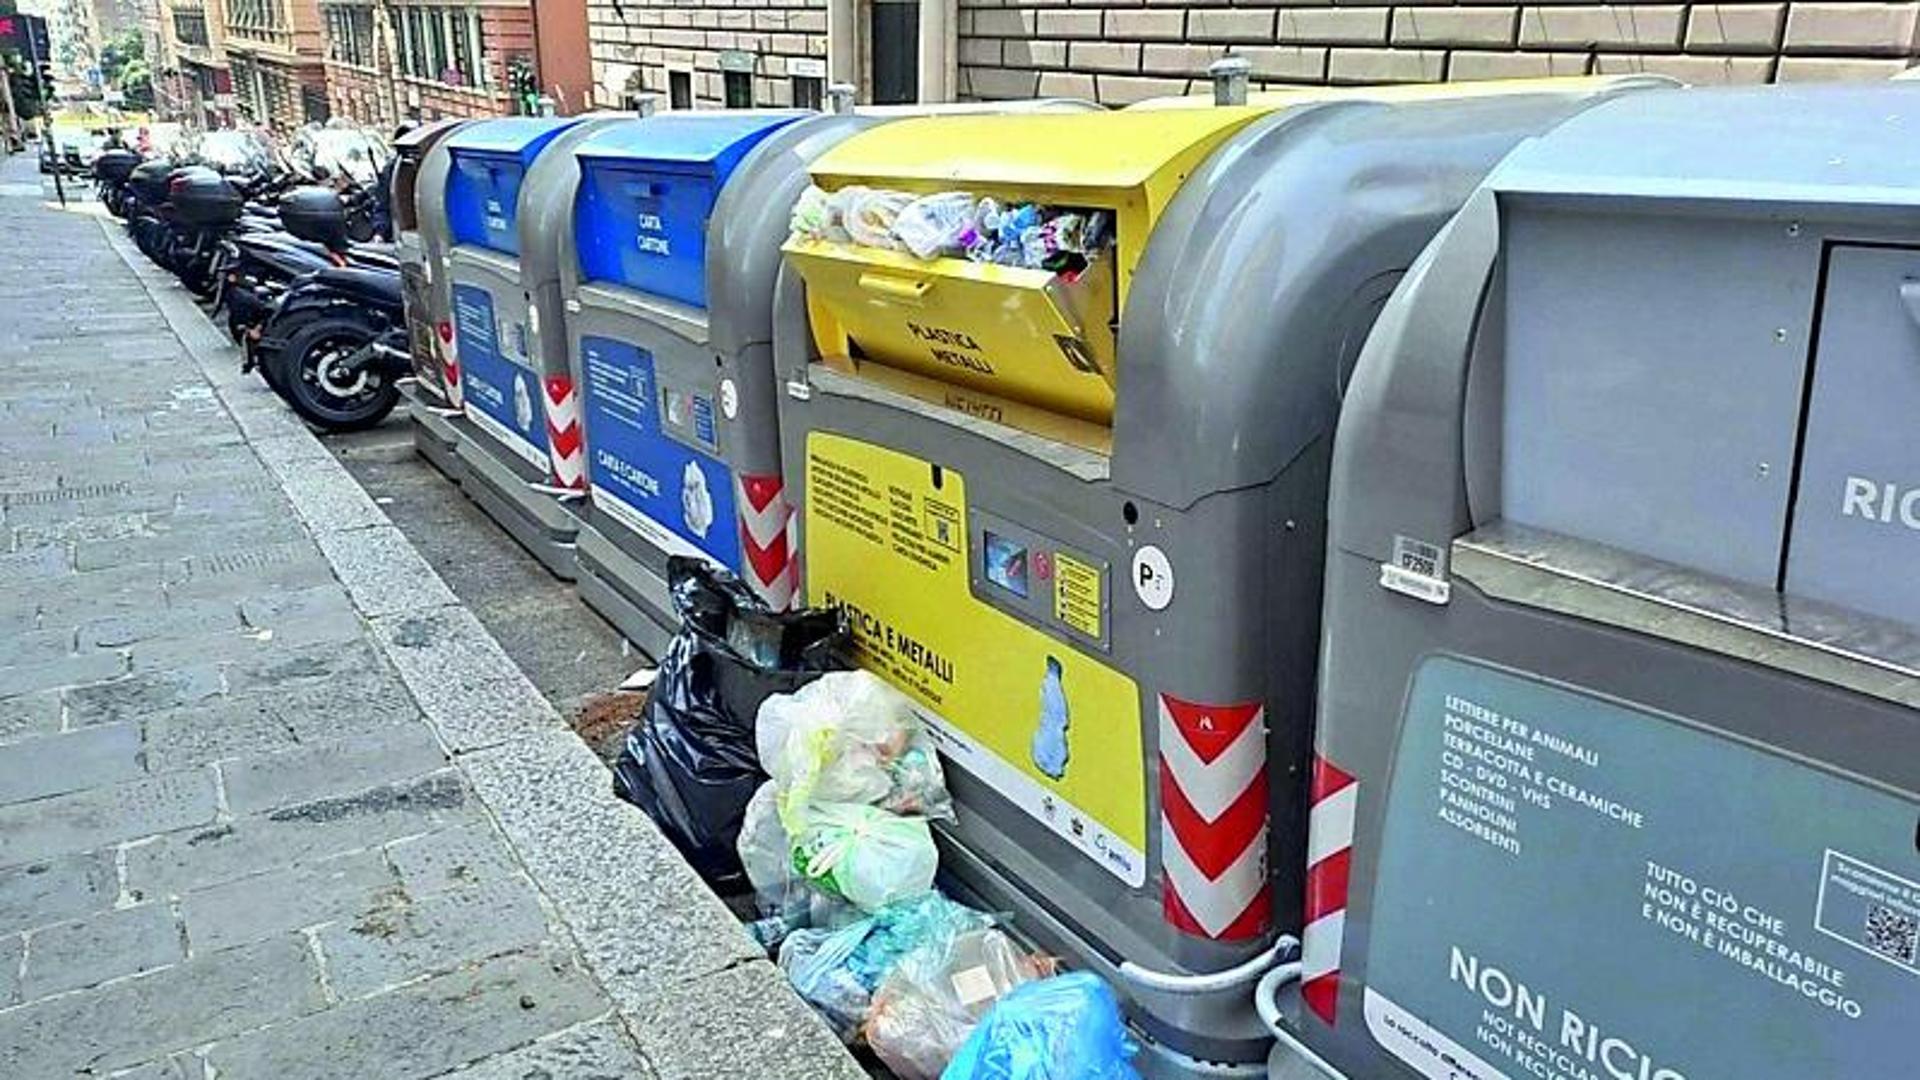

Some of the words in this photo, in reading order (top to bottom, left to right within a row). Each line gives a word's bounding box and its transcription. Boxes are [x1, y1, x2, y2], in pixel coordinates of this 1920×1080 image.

[907, 321, 981, 351] PLASTICA
[930, 347, 993, 374] METALLI
[887, 626, 894, 648] E
[898, 633, 953, 684] METALLI
[1445, 695, 1500, 727] LETTIERE
[1503, 717, 1528, 739] PER
[1532, 731, 1599, 766] ANIMALI
[1445, 714, 1534, 761] PORCELLANE
[1441, 769, 1515, 813] SCONTRINI
[1443, 732, 1530, 781] TERRACOTTA
[1535, 771, 1543, 785] E
[1546, 777, 1644, 828] CERAMICHE
[1443, 751, 1463, 770] CD
[1476, 765, 1507, 789] DVD
[1522, 785, 1551, 810] VHS
[1439, 807, 1520, 855] ASSORBENTI
[1440, 788, 1517, 833] PANNOLINI
[1648, 862, 1697, 895] TUTTO
[1702, 887, 1738, 913] CIÒ
[1744, 906, 1784, 935] CHE
[1643, 904, 1653, 918] E
[1657, 911, 1699, 941] NON
[1718, 939, 1861, 1018] IMBALLAGGIO
[1645, 883, 1686, 913] NON
[1705, 911, 1844, 987] RECUPERABILE
[1450, 945, 1546, 1031] NON
[1560, 1009, 1686, 1080] RICI
[1482, 1009, 1514, 1037] NOT
[1477, 1026, 1512, 1057] NON
